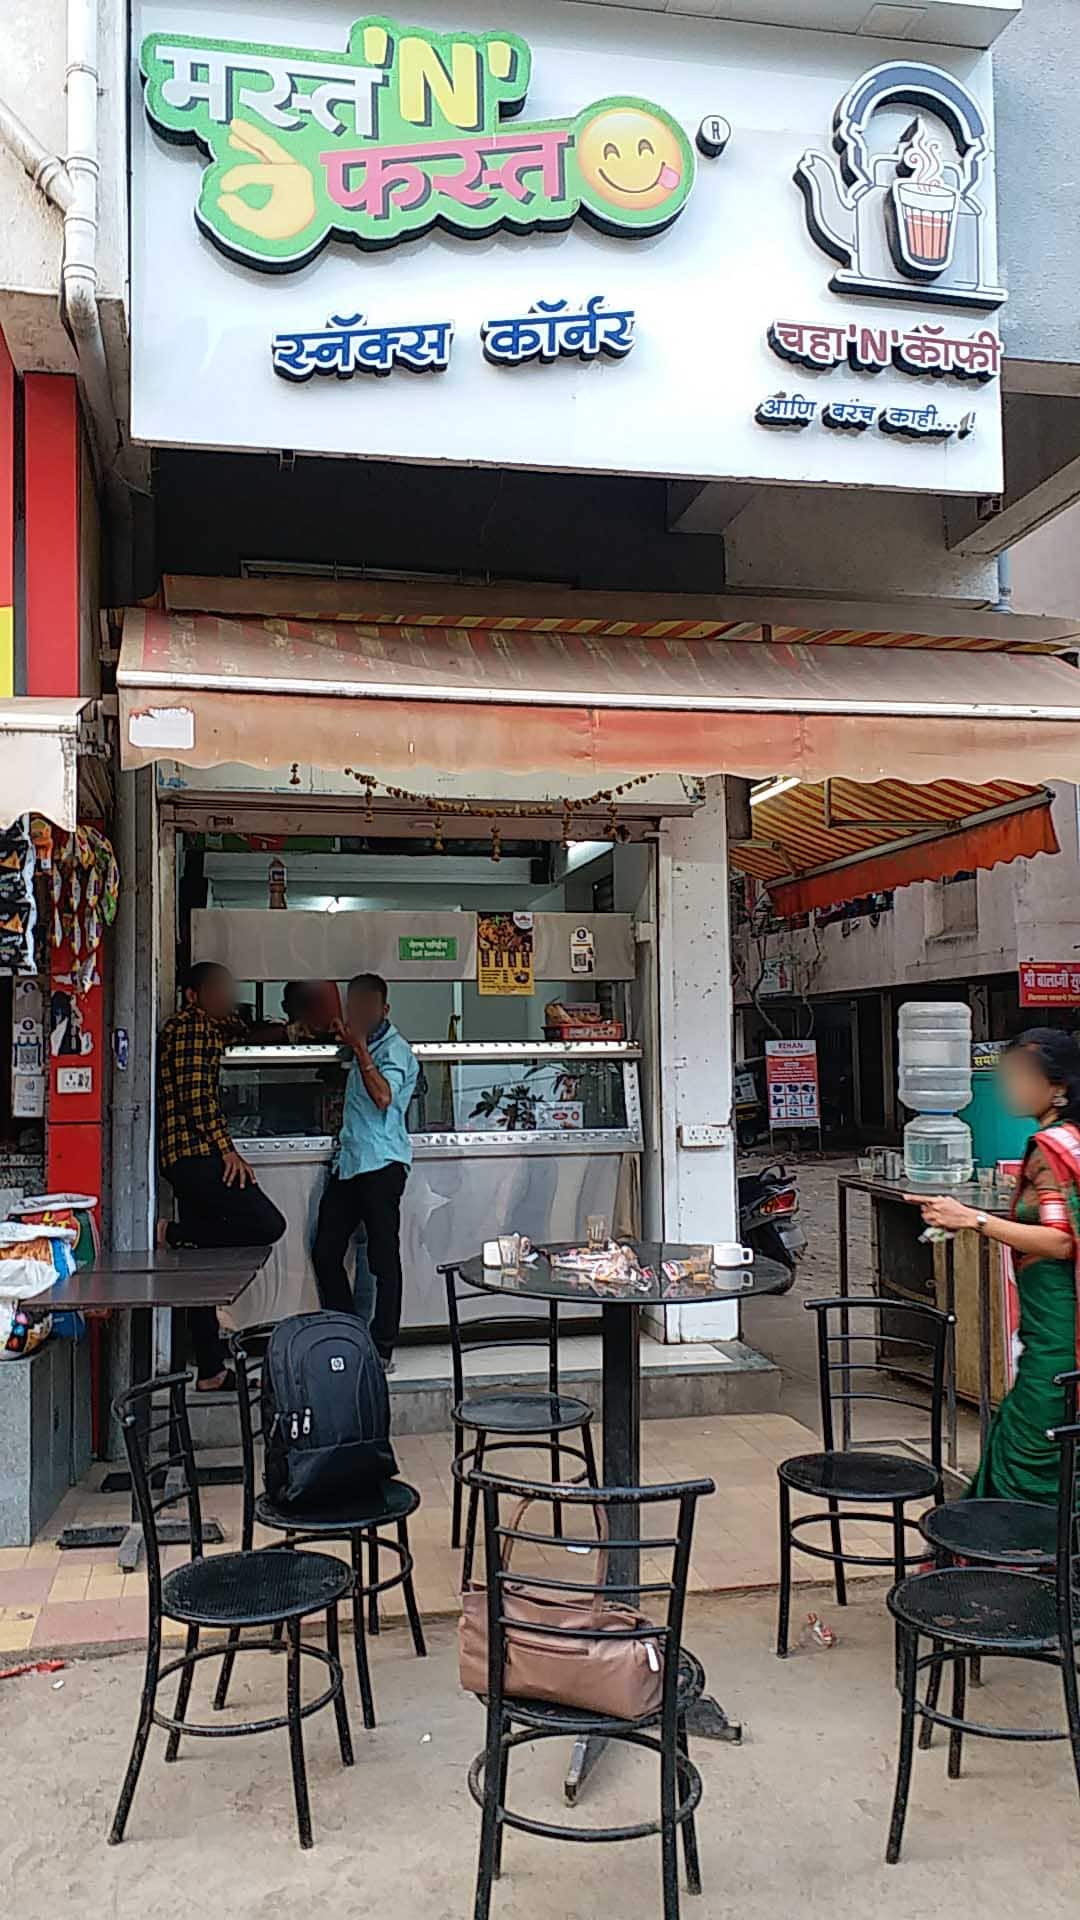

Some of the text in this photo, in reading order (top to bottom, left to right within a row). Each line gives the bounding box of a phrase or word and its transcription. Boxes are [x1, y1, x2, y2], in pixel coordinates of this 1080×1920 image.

[155, 45, 382, 137] मस्त
[320, 131, 570, 216] फस्त
[273, 297, 635, 371] स्नॅक्स कॉर्नर
[764, 395, 816, 418] आणि
